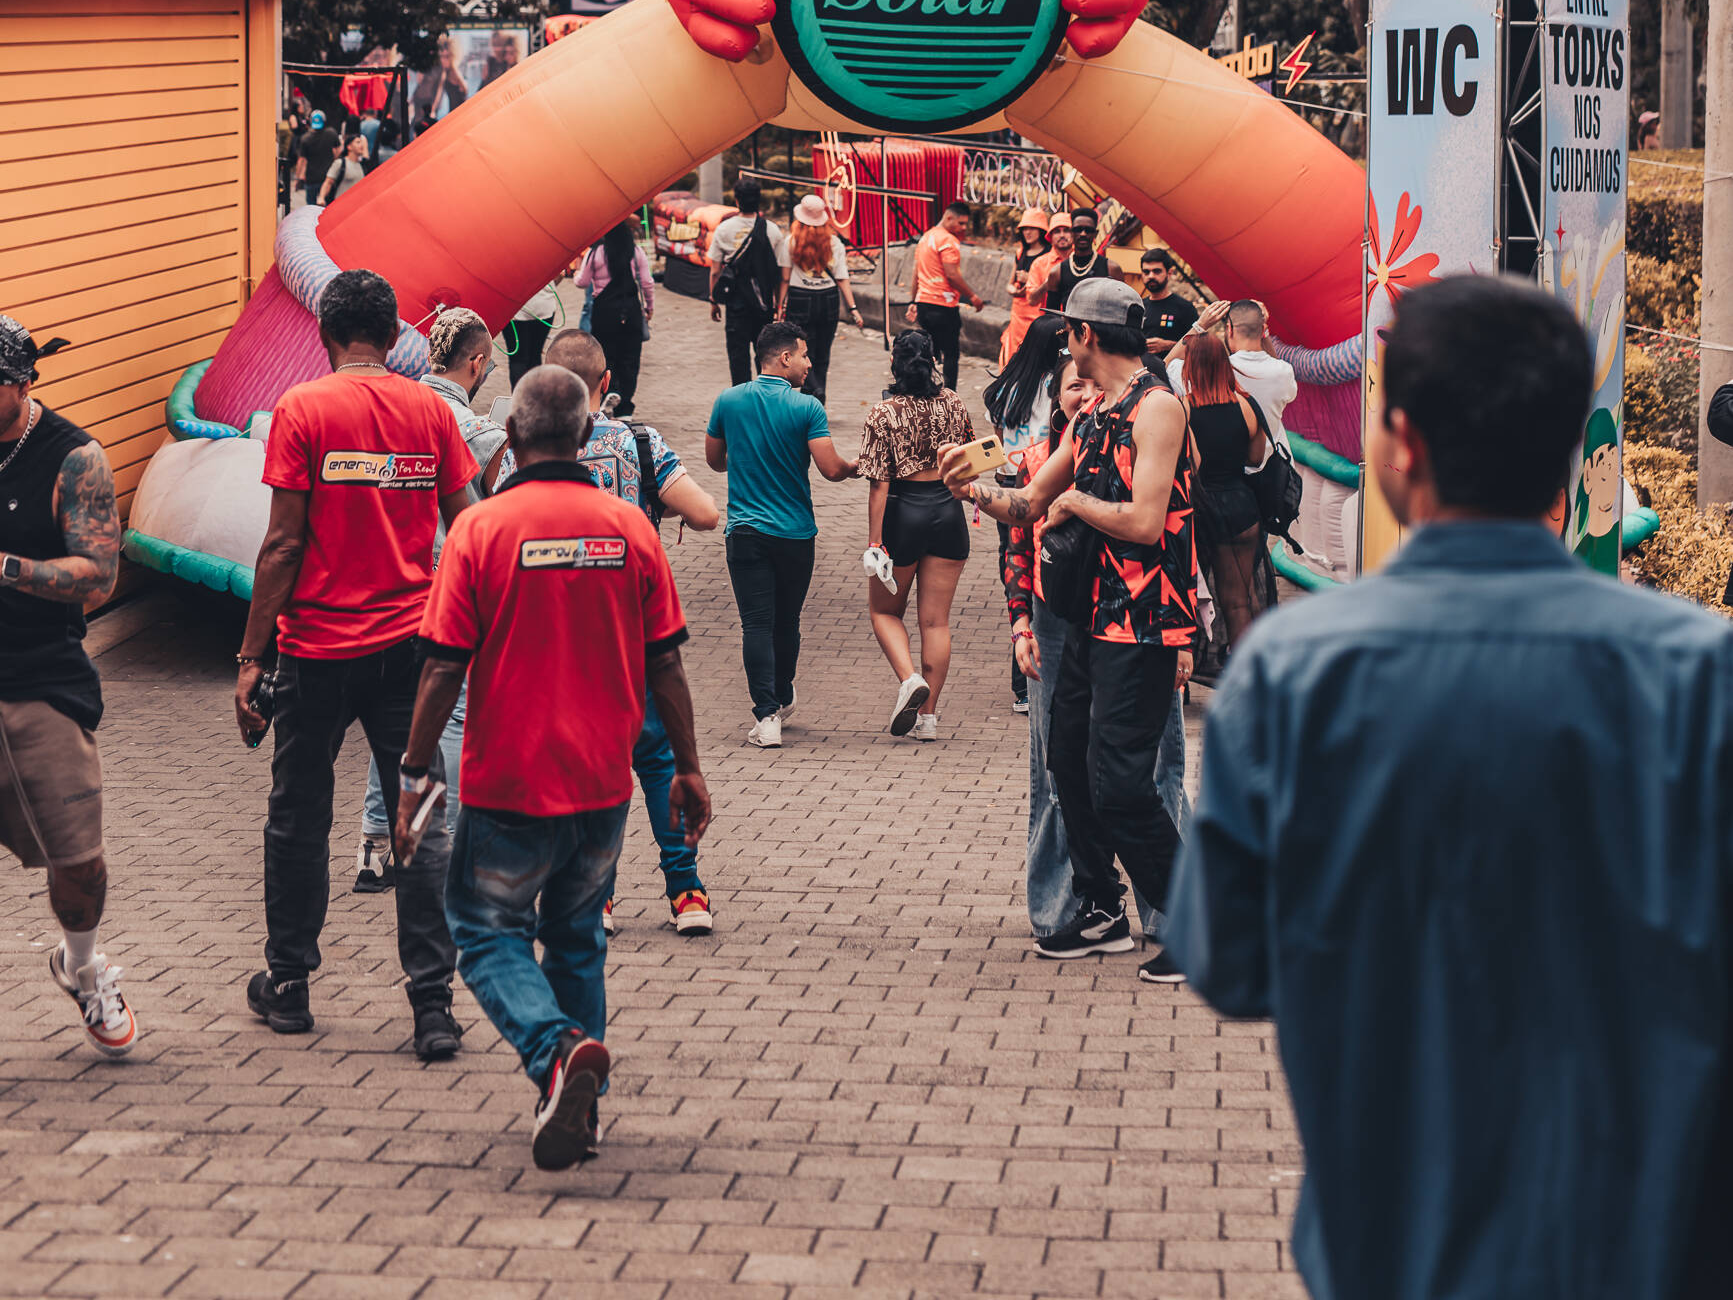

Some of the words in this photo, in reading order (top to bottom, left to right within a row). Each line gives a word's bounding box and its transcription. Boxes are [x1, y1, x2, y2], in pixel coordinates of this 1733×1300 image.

[1386, 24, 1479, 117] WC
[1549, 24, 1624, 91] TODXS
[1574, 94, 1601, 140] NOS
[1550, 146, 1620, 194] CUIDAMOS
[328, 460, 378, 474] energy
[399, 462, 412, 473] For
[414, 461, 436, 474] Rent
[527, 547, 571, 558] energy
[604, 543, 622, 553] Rent
